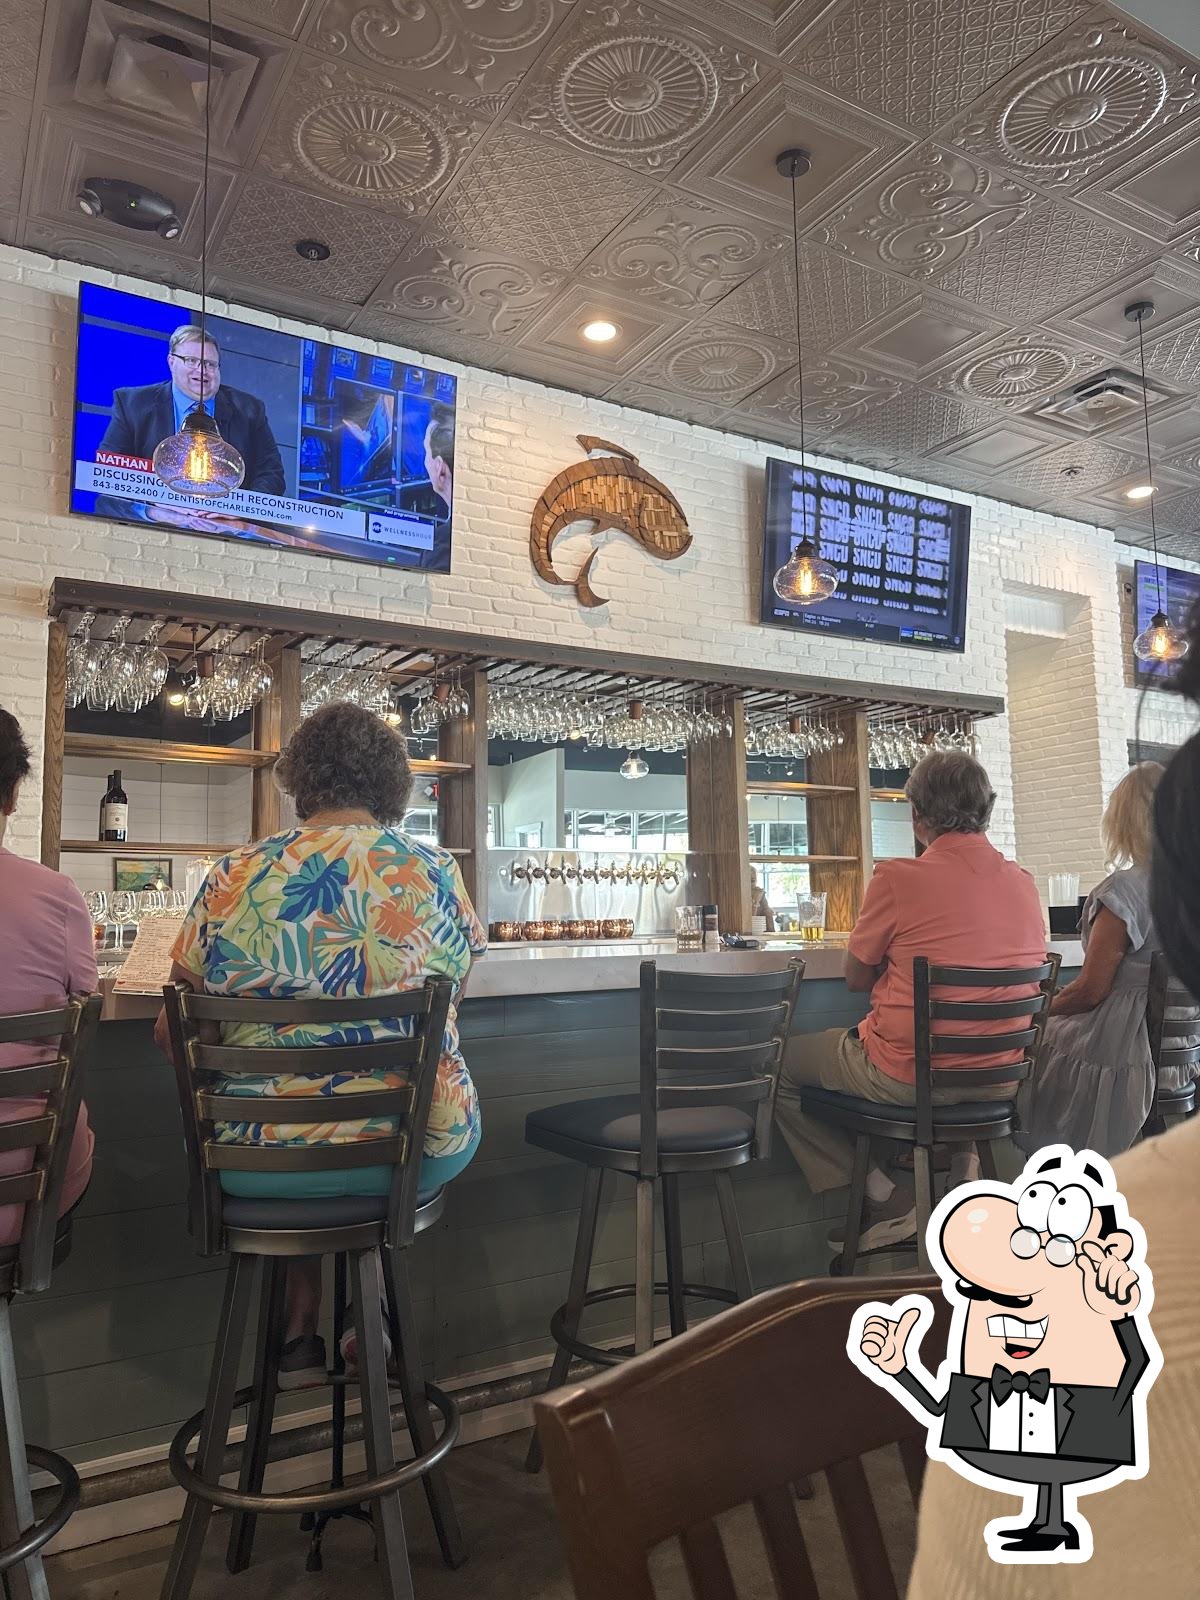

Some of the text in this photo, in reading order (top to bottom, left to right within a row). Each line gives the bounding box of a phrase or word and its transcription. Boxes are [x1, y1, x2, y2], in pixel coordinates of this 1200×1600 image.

[96, 452, 148, 471] NATHAN
[92, 479, 158, 498] 843-852-2400
[167, 492, 293, 521] DENTISTOFCHARLESTON.com
[248, 494, 344, 520] RECONSTRUCTION
